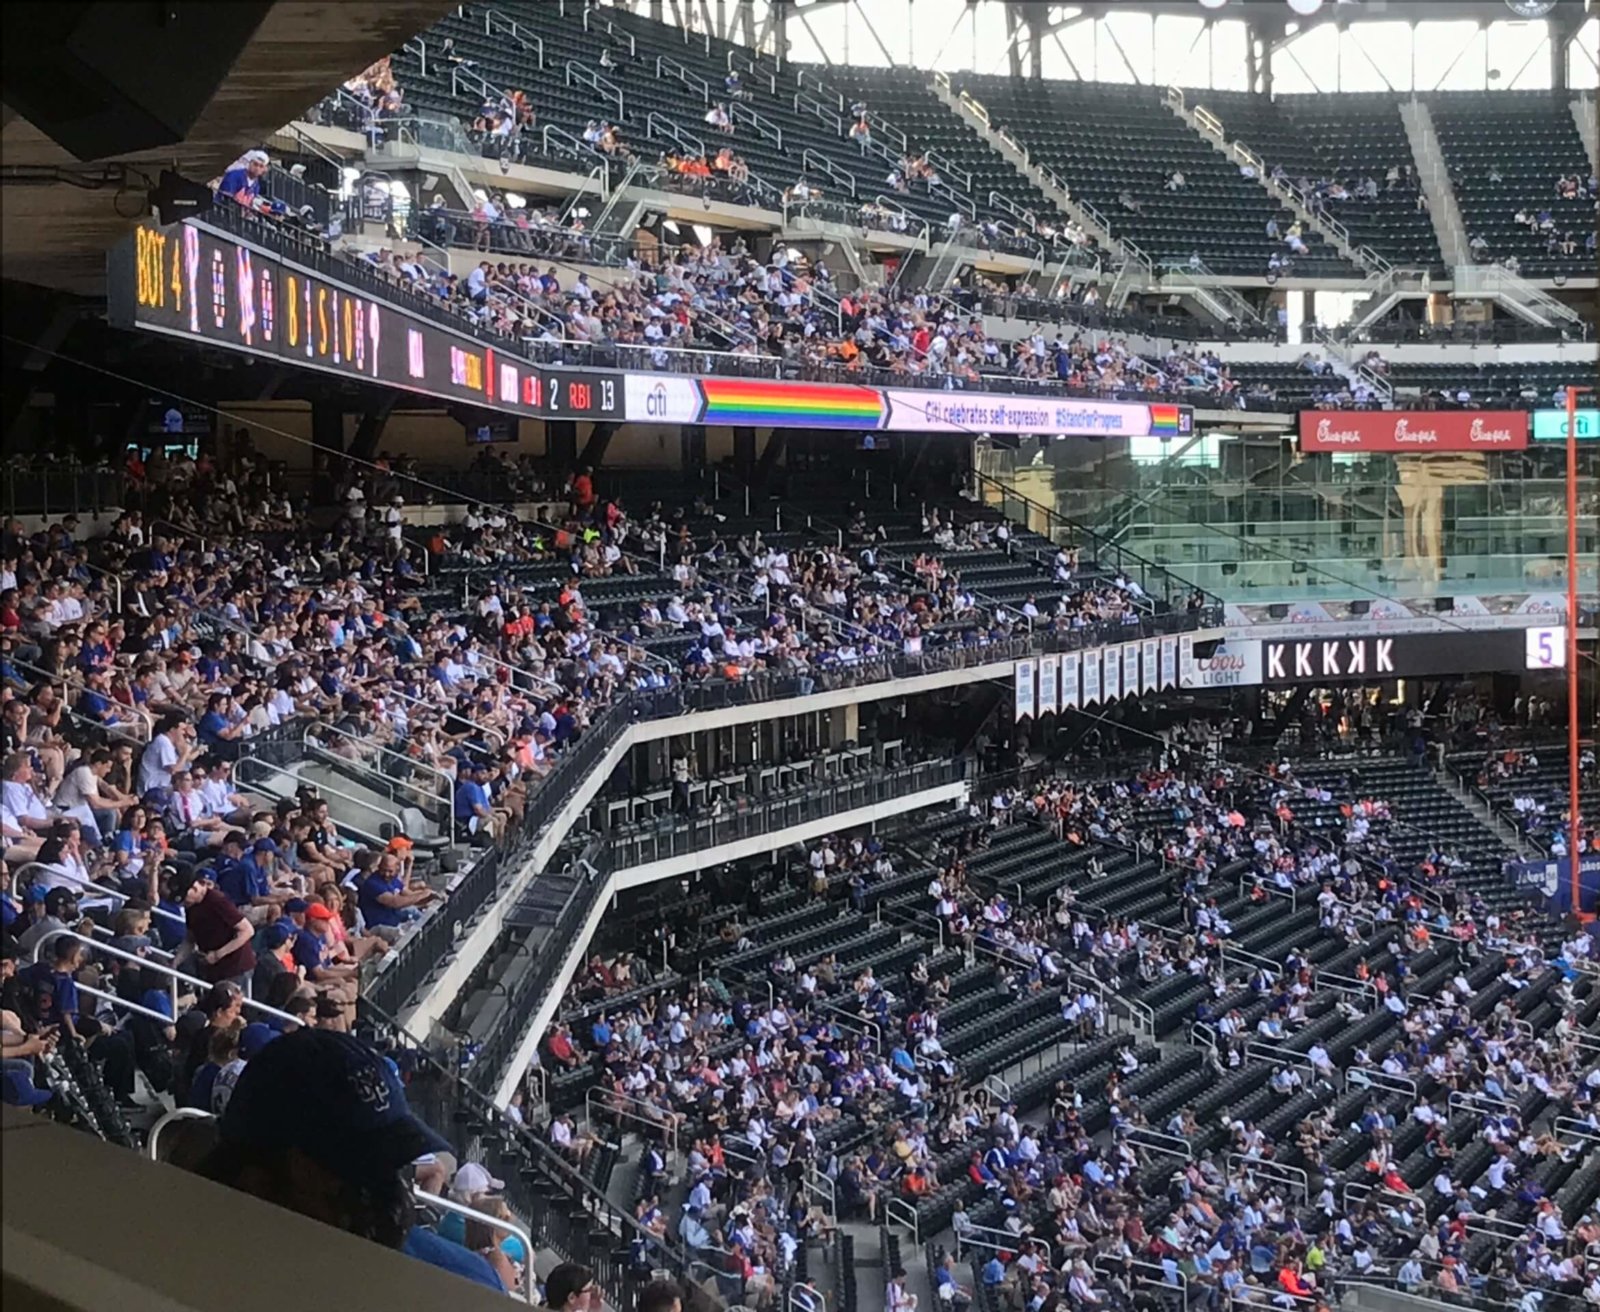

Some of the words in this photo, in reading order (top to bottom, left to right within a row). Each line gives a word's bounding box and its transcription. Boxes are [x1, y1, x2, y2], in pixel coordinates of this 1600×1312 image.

[137, 225, 165, 308] BOT
[171, 238, 182, 311] 4
[288, 277, 298, 346] B
[319, 288, 328, 354] S
[550, 378, 558, 410] 2
[569, 383, 592, 409] RBI
[600, 380, 614, 411] 13
[647, 387, 667, 416] citi
[925, 401, 941, 423] Citi
[944, 403, 988, 425] celebrates
[990, 405, 1049, 430] self-expression
[1056, 407, 1123, 432] #StandForProgress
[1560, 417, 1588, 434] cti
[1198, 653, 1245, 671] Coors
[1538, 632, 1553, 664] 5
[1203, 670, 1240, 685] LIGHT
